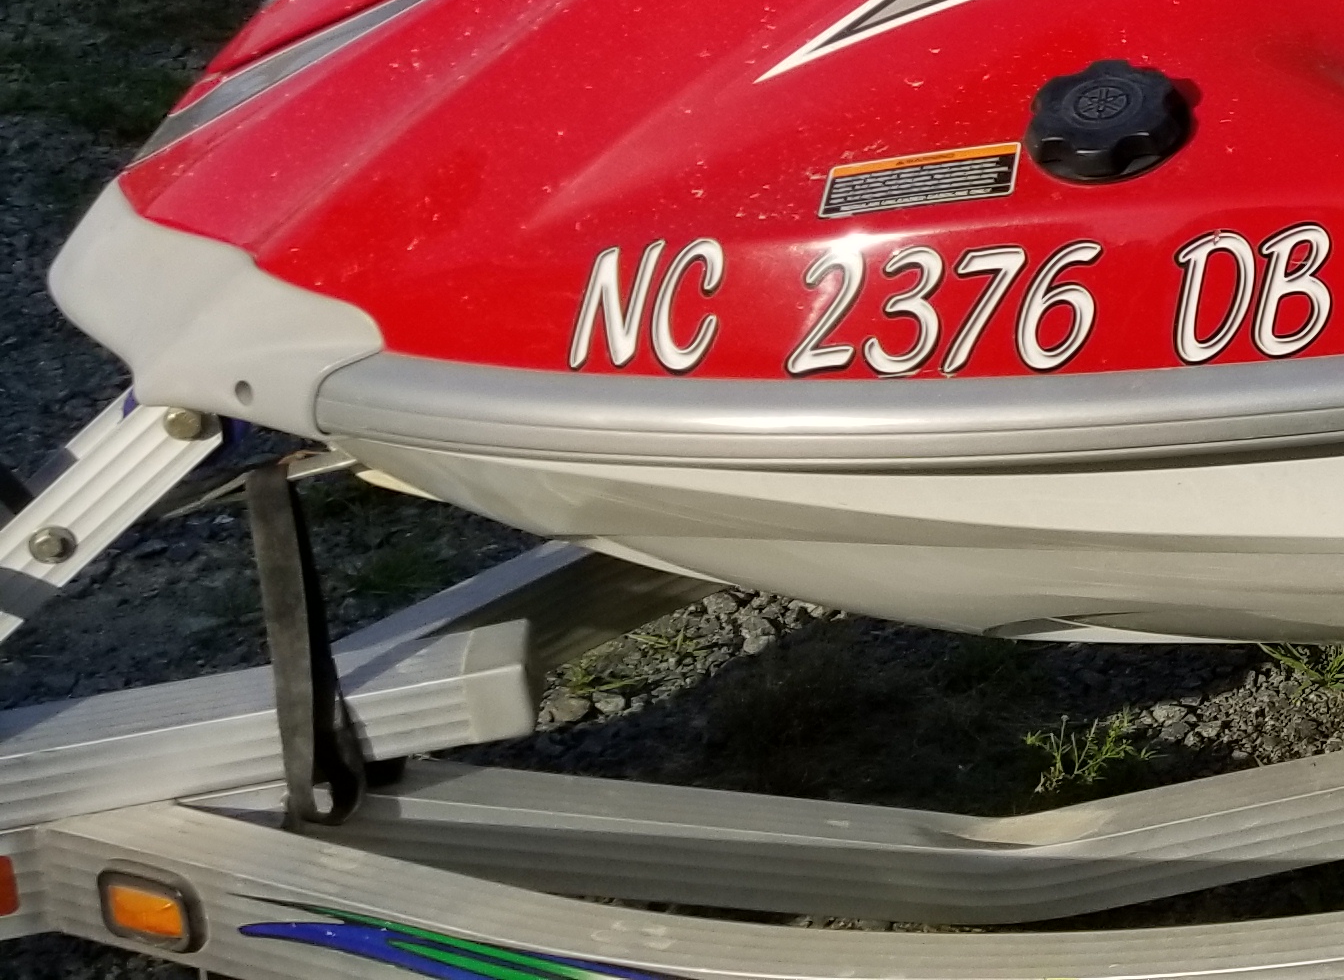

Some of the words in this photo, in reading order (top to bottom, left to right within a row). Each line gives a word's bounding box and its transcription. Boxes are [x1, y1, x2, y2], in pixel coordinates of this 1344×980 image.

[569, 237, 724, 374] NC
[785, 239, 1103, 377] 2376
[1172, 221, 1333, 366] DB
